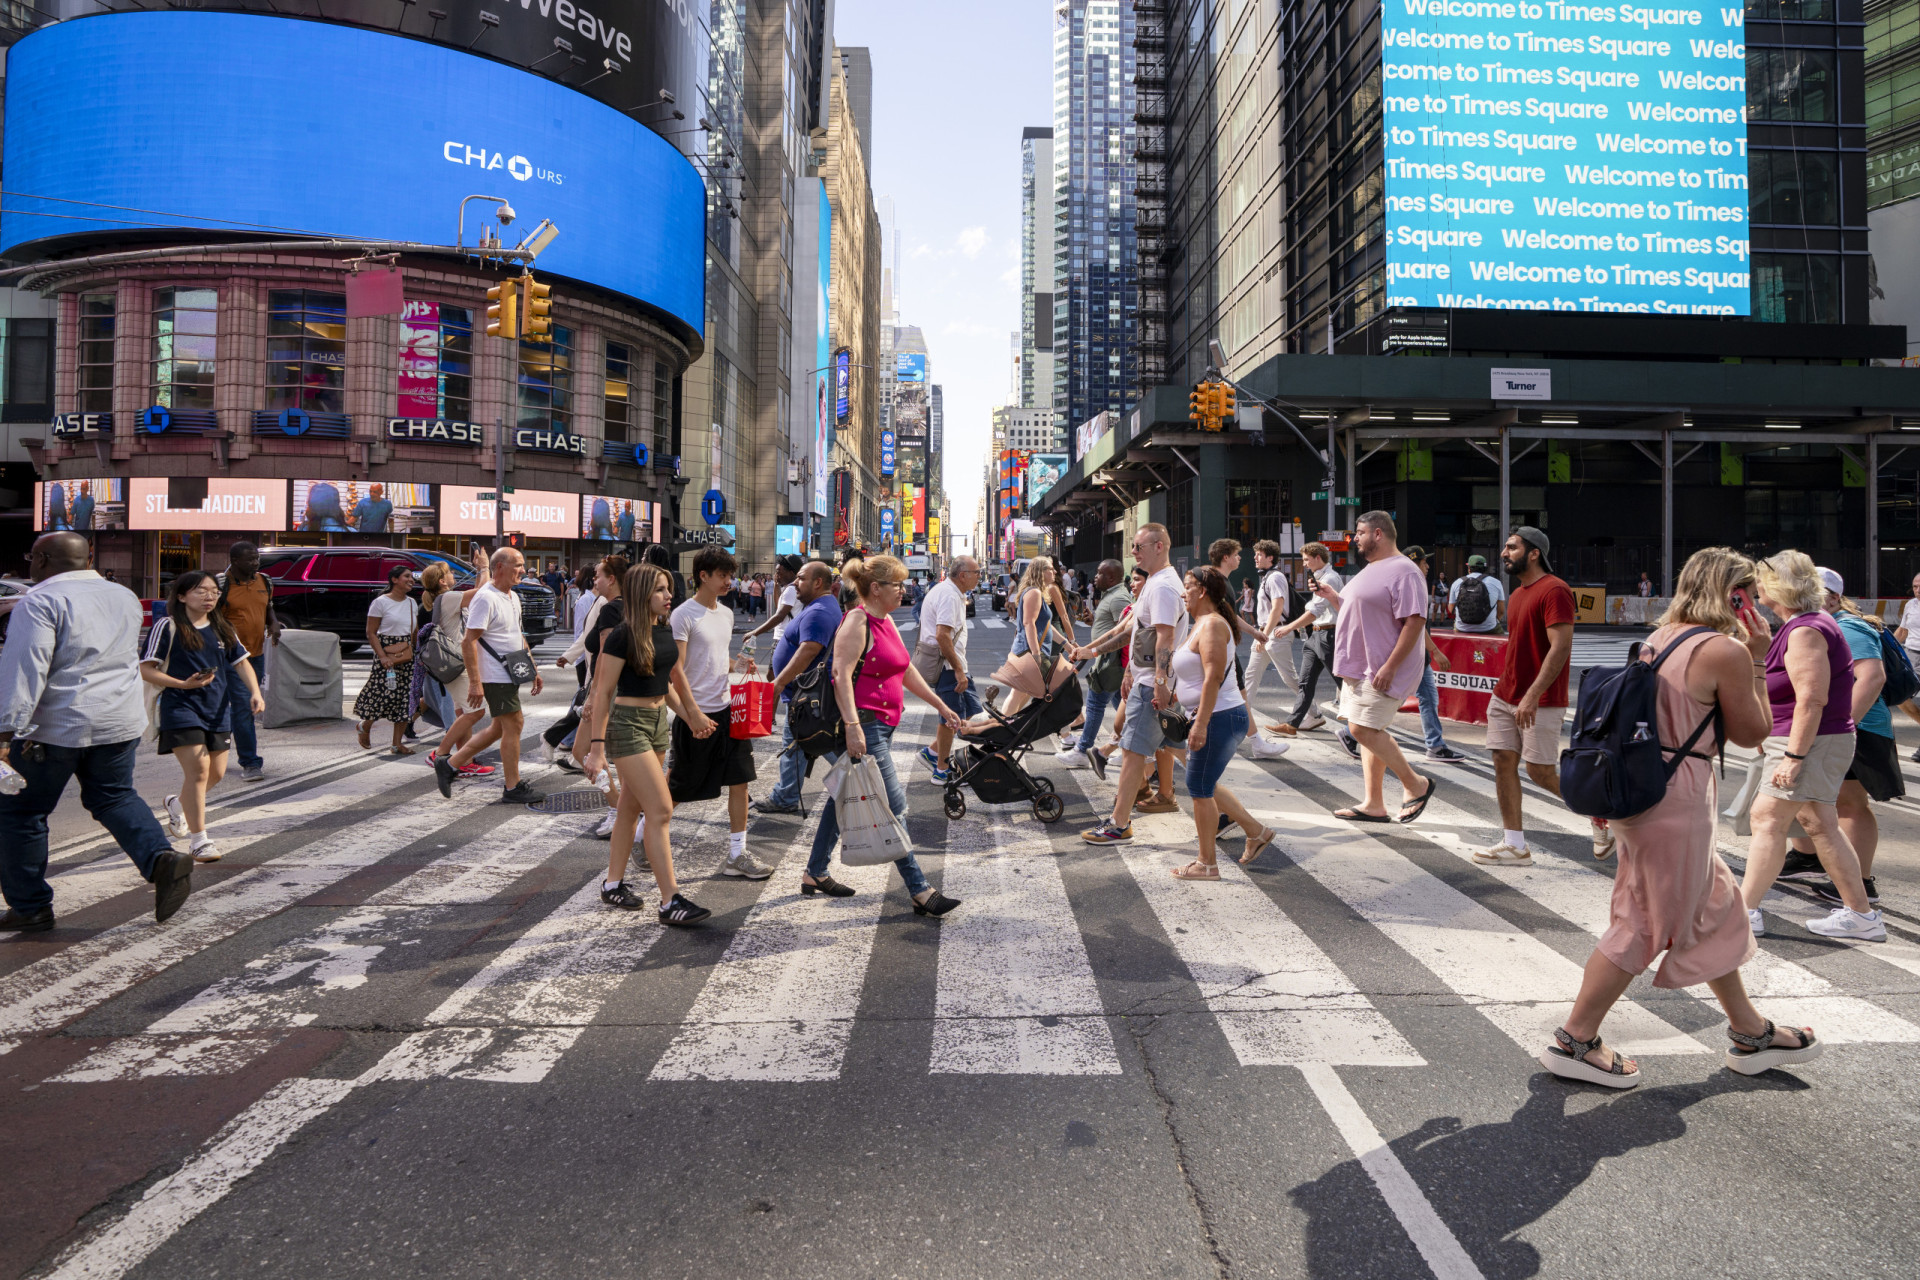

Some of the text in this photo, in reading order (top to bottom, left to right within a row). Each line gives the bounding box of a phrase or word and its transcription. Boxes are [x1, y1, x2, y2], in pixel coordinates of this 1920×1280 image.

[1404, 0, 1516, 18] Welcome
[1518, 1, 1543, 19] to
[1545, 0, 1616, 22] Times
[1619, 4, 1702, 30] Square
[1486, 32, 1511, 51] to
[1514, 31, 1585, 53] Times
[1588, 36, 1671, 61] Square
[1689, 39, 1746, 59] Welc
[1455, 63, 1479, 82] to
[1482, 62, 1553, 84] Times
[1556, 67, 1640, 92] Square
[1423, 94, 1447, 113] to
[1450, 93, 1521, 116] Times
[1525, 98, 1608, 124] Square
[1627, 102, 1737, 123] Welcome
[1391, 126, 1415, 145] to
[1418, 125, 1490, 148] Times
[1493, 129, 1577, 155] Square
[1596, 133, 1706, 155] Welcome
[1709, 138, 1732, 156] to
[1735, 138, 1748, 156] T
[1387, 157, 1748, 189] Times Square Welcome to Tim
[1429, 194, 1514, 219] Square
[1533, 197, 1644, 219] Welcome
[1647, 201, 1671, 219] to
[1674, 200, 1743, 222] Times
[1397, 226, 1482, 252] Square
[1501, 229, 1613, 251] Welcome
[1616, 233, 1640, 252] to
[1642, 232, 1712, 254] Times
[1469, 261, 1581, 283] Welcome
[1584, 265, 1608, 284] to
[1611, 264, 1681, 286] Times
[1437, 294, 1549, 311] Welcome
[1553, 297, 1576, 311] to
[1579, 296, 1649, 313] Times
[1506, 381, 1536, 390] Turner
[52, 414, 100, 433] ASE
[389, 418, 482, 443] CHASE
[516, 430, 587, 454] CHASE
[145, 494, 266, 514] STE MADDEN
[460, 502, 505, 520] STEV
[510, 504, 565, 524] MADDEN
[685, 530, 722, 544] CHASE
